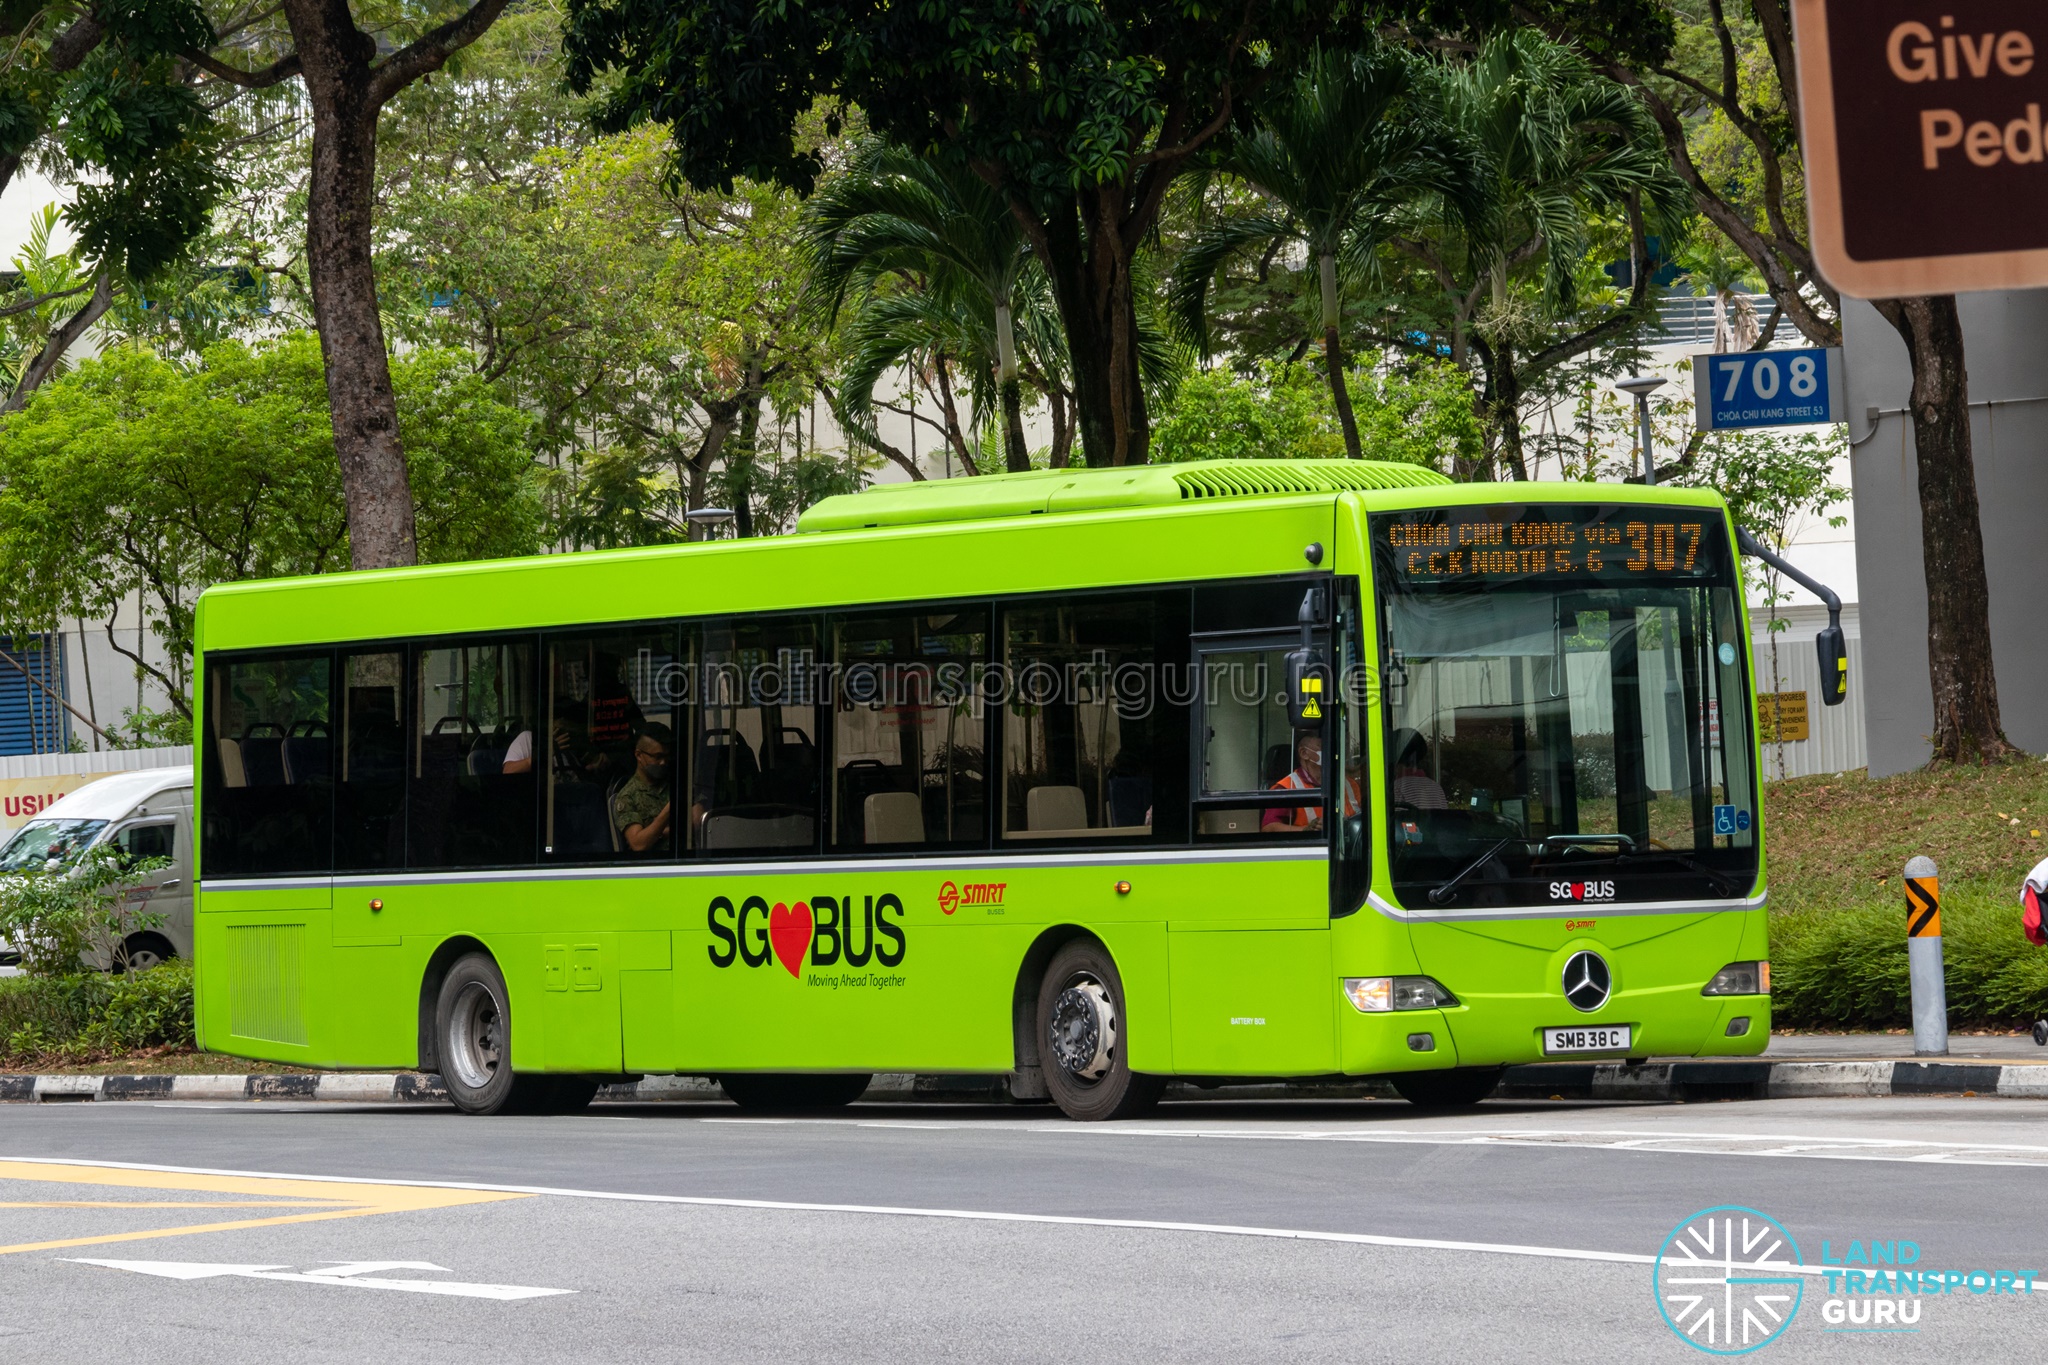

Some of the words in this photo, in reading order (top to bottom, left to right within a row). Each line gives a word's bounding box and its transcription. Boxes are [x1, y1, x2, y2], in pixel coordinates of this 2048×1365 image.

[1886, 15, 2035, 83] Give
[1921, 103, 2048, 170] Ped
[1719, 356, 1817, 402] 708
[1717, 410, 1741, 421] CHOA
[1742, 409, 1759, 420] CHU
[1761, 408, 1784, 418] KANG
[1785, 406, 1811, 417] STREET
[1813, 405, 1824, 416] 53
[1389, 522, 1450, 547] CHOA
[1458, 522, 1503, 546] CHU
[1511, 521, 1576, 545] KANG
[1584, 521, 1621, 544] via
[1626, 521, 1702, 571] 307
[1471, 550, 1546, 573] NORTH
[1586, 549, 1604, 573] 6
[4, 793, 65, 817] USU
[960, 883, 1007, 904] SMRT
[1575, 920, 1597, 928] SMRT
[807, 973, 839, 990] Moving
[839, 973, 867, 987] Ahead
[868, 973, 906, 990] Together
[1230, 1017, 1253, 1025] BATTERY
[1254, 1017, 1266, 1025] BOX
[1555, 1032, 1586, 1048] SMB
